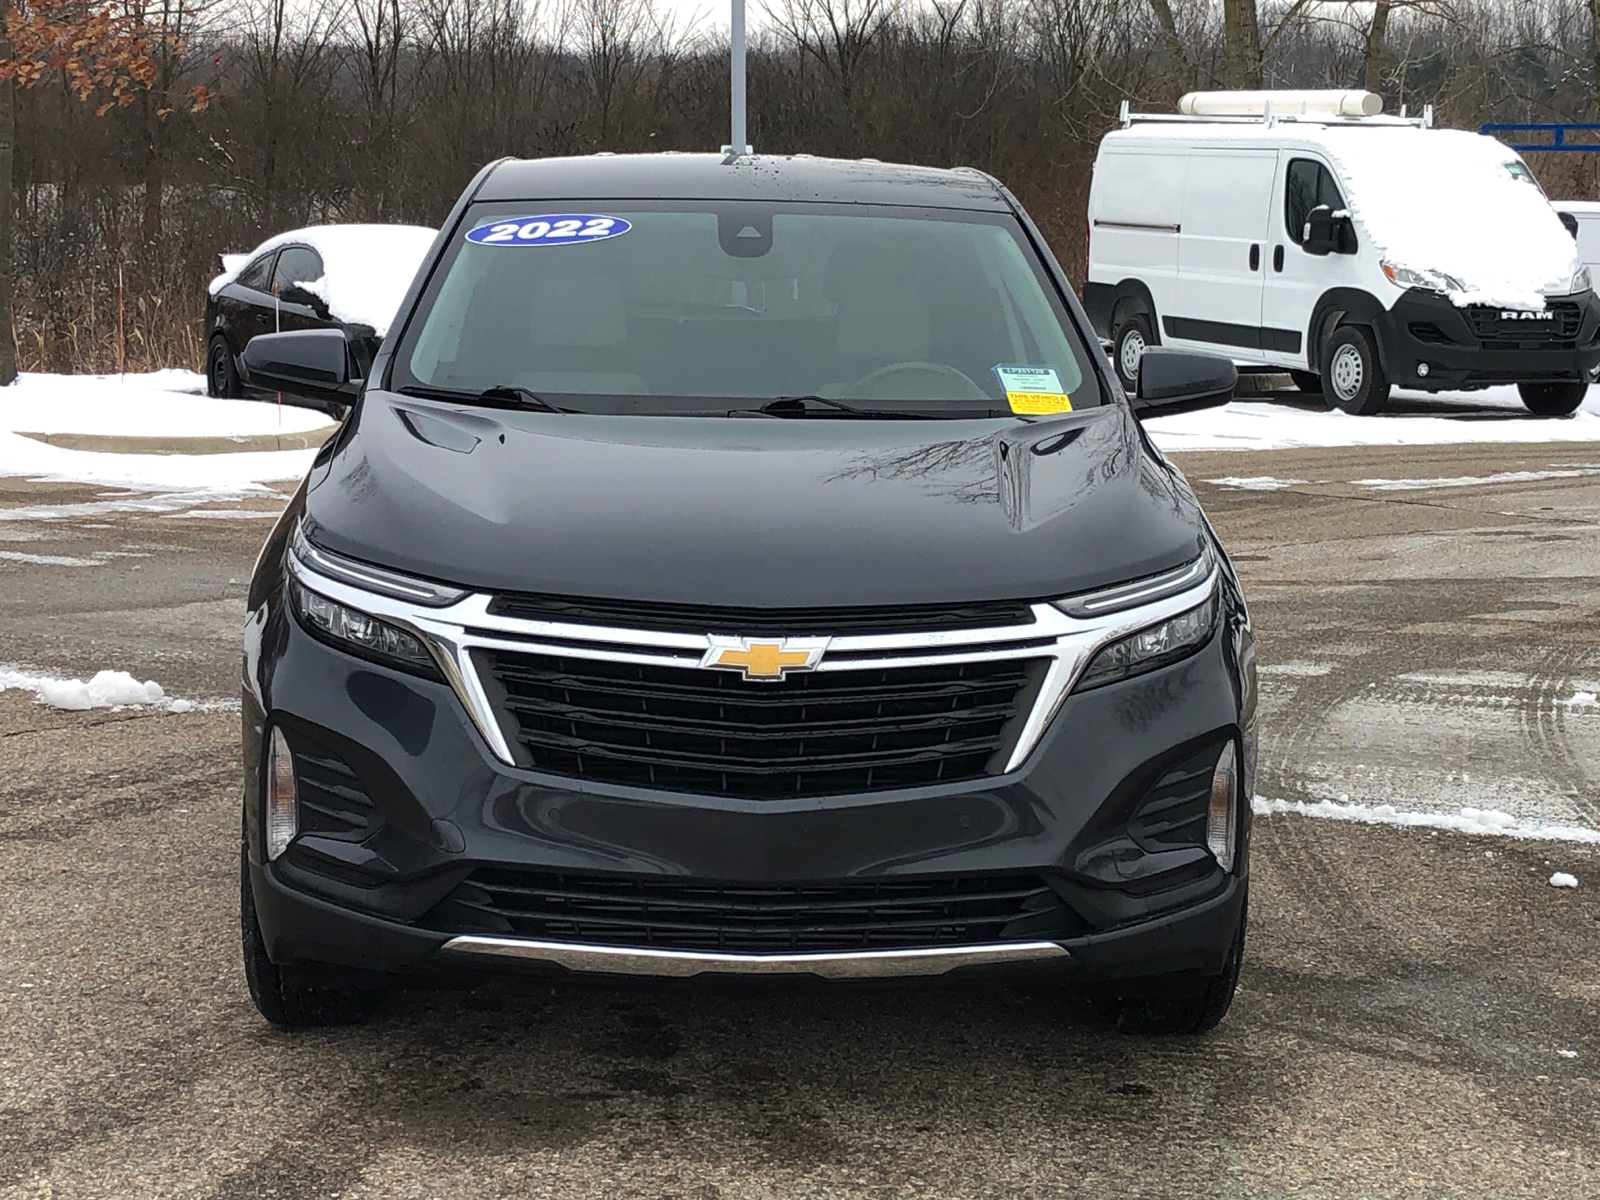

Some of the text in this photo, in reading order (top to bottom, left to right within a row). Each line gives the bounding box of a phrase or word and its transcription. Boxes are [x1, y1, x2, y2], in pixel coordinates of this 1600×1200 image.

[482, 218, 615, 242] 2022
[1501, 311, 1554, 320] RAM
[1030, 394, 1067, 402] VEHICLE
